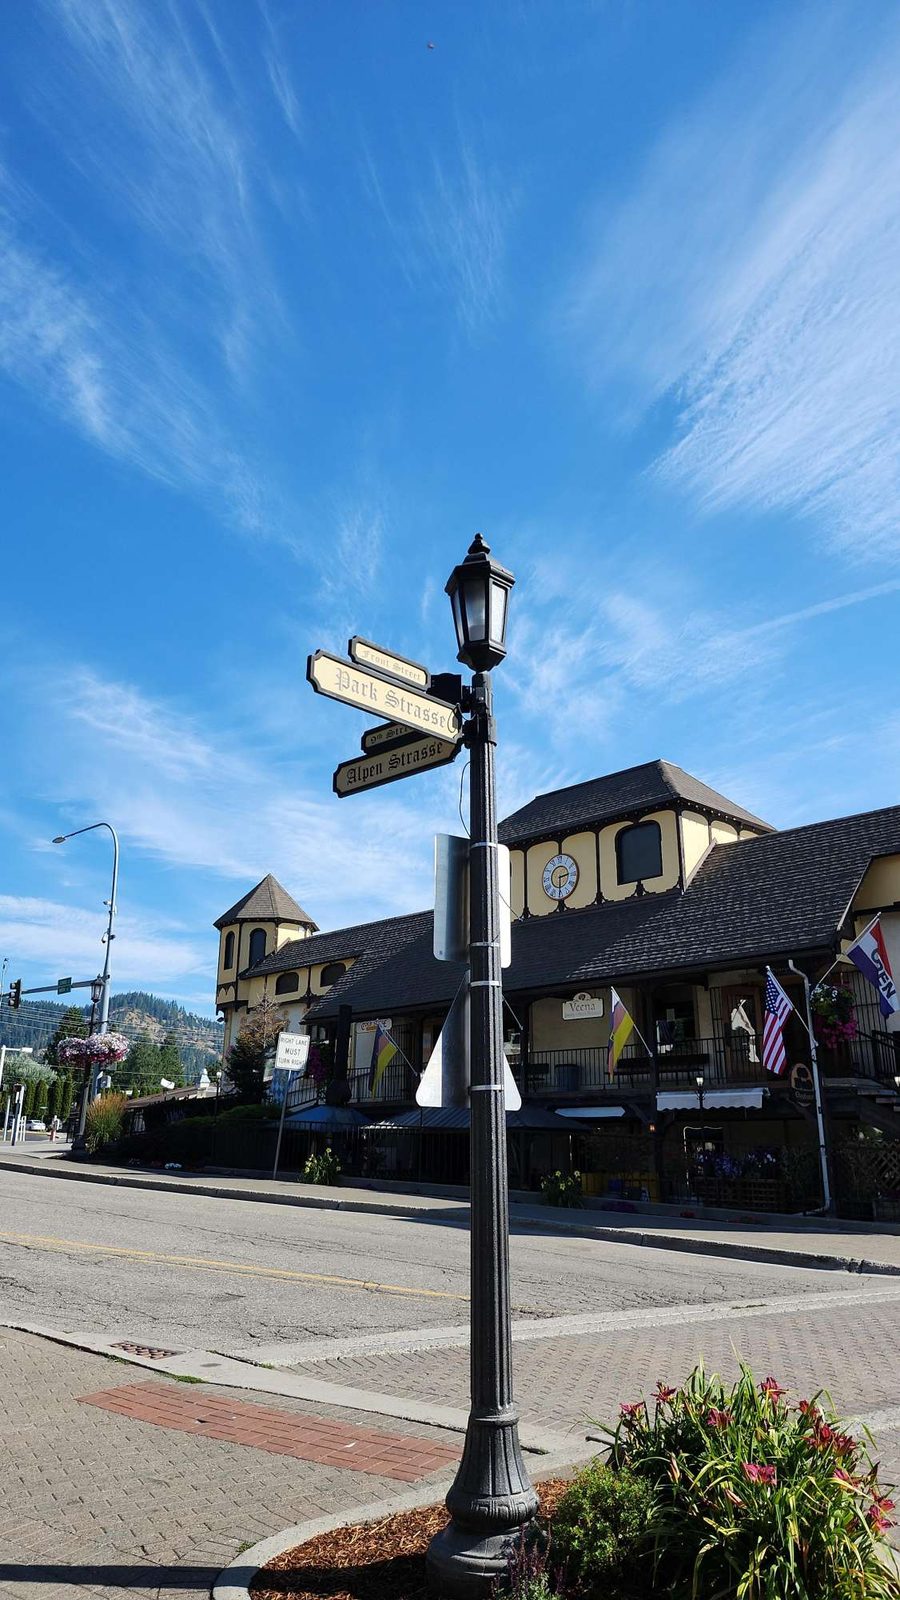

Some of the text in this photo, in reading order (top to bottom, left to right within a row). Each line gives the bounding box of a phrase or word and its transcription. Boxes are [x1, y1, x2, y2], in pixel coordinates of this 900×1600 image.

[362, 650, 421, 681] Front Street
[335, 668, 446, 729] Park Strasse
[346, 741, 443, 786] Alpen Strasse
[285, 1047, 301, 1057] MUST
